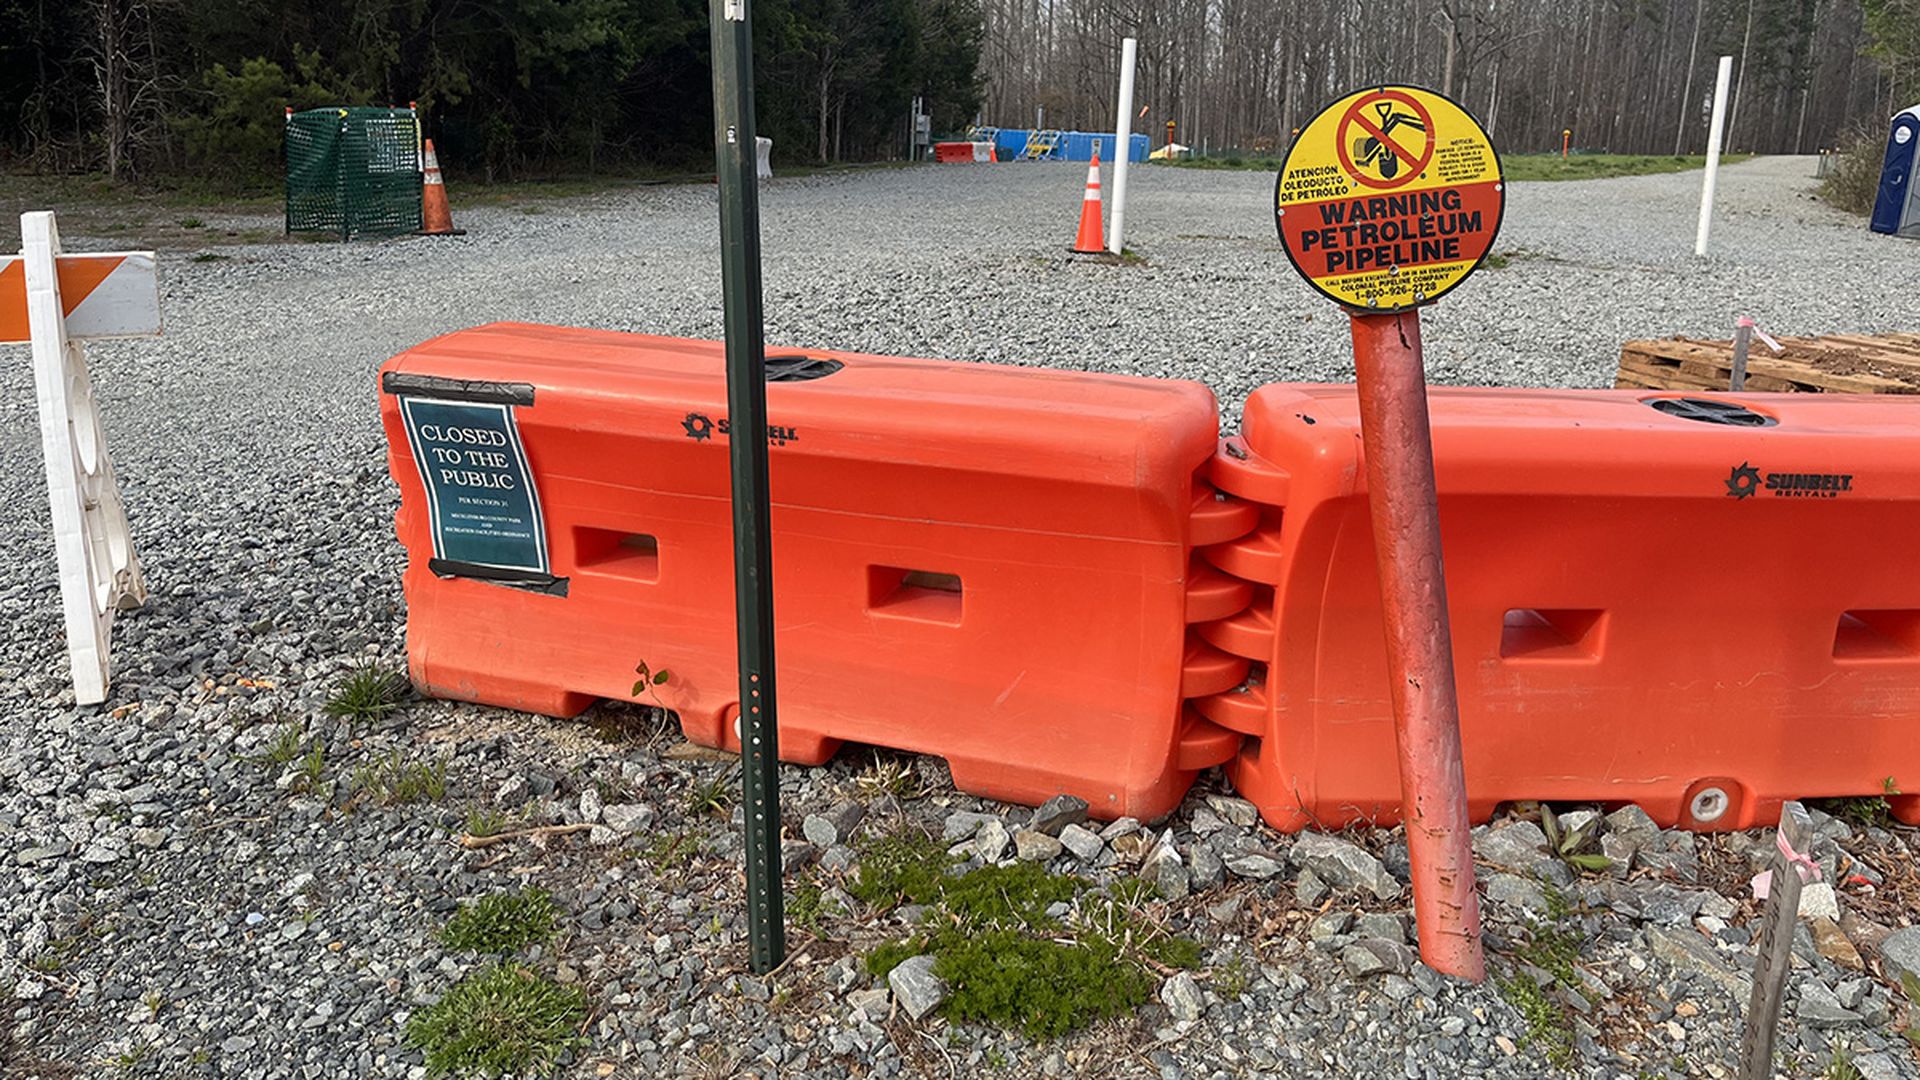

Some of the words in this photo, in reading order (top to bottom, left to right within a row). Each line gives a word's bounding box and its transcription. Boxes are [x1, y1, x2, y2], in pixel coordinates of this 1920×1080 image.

[1284, 175, 1344, 191] OLEODUCTO
[1281, 192, 1294, 202] DE
[1319, 189, 1462, 225] WARNING
[1302, 211, 1483, 251] PETROLEUM
[1326, 238, 1461, 273] PIPELINE
[1341, 282, 1377, 292] COLONIAL
[1379, 277, 1411, 287] PIPELINE
[1413, 273, 1450, 282] COMPANY
[1355, 281, 1438, 300] 1-800-926-2728
[421, 424, 507, 447] CLOSED
[432, 447, 462, 465] TO
[464, 450, 509, 468] THE
[440, 469, 515, 490] PUBLIC
[1775, 490, 1837, 498] RENTALS
